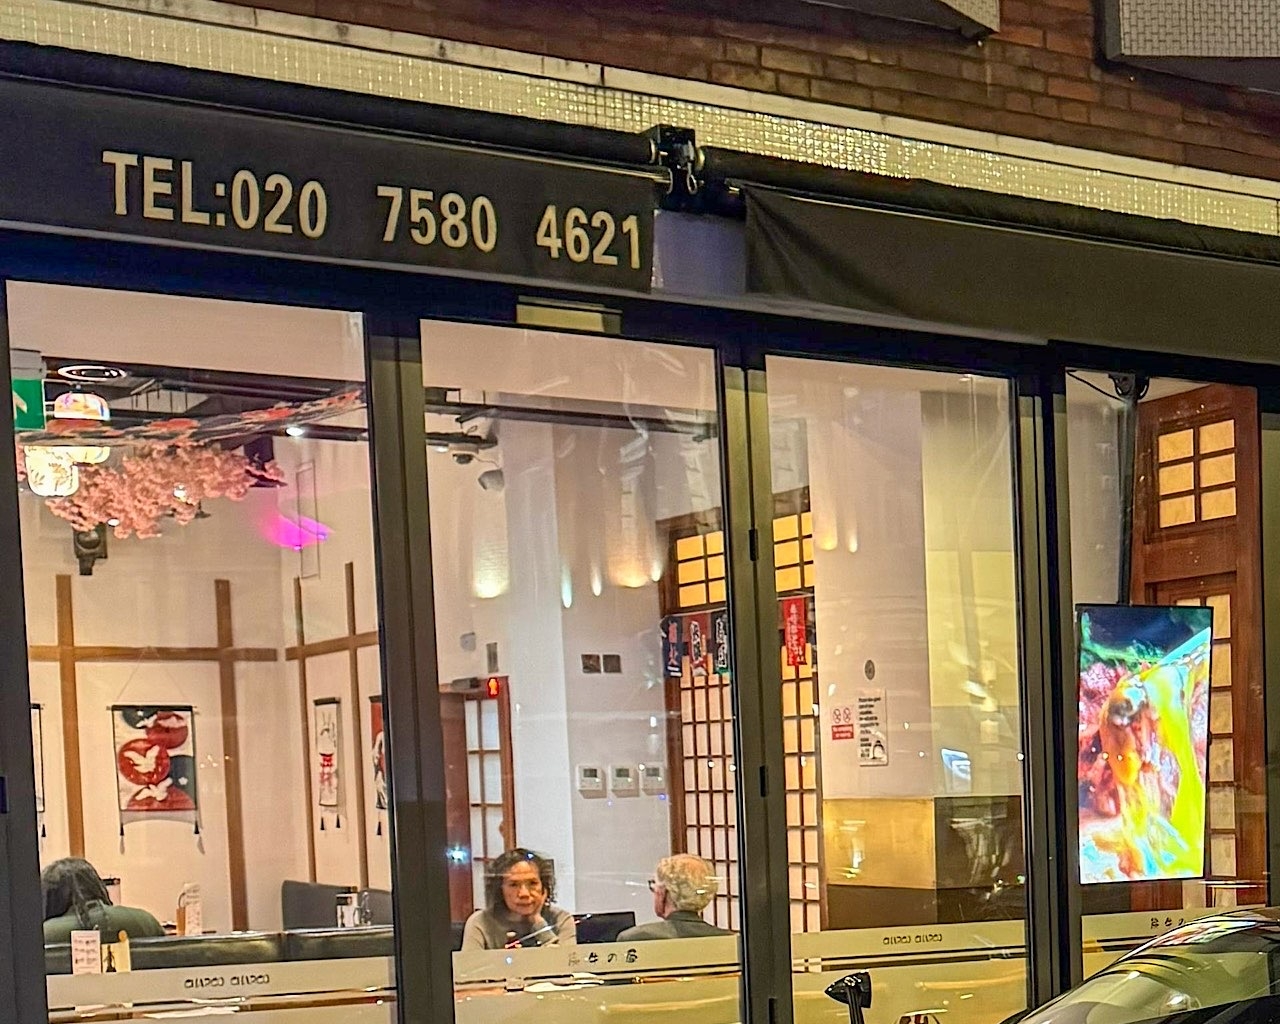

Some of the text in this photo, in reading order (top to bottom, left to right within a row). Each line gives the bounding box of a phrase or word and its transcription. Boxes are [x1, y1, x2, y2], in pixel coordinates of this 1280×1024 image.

[102, 150, 642, 270] TEL:020 7580 4621
